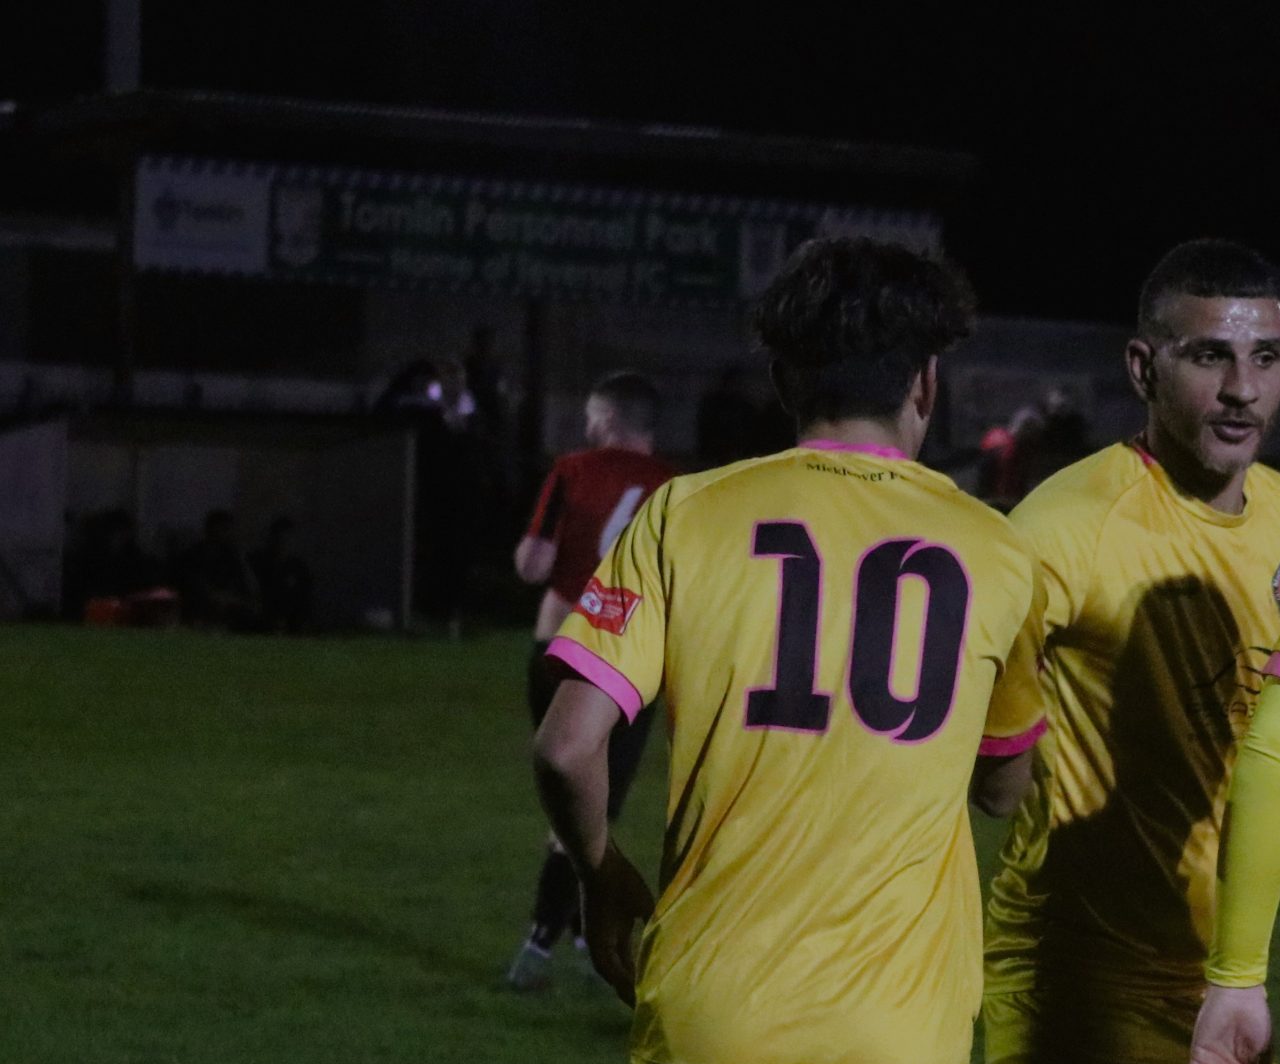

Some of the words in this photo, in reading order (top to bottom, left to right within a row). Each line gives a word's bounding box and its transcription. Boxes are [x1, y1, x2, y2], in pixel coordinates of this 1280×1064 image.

[340, 189, 455, 235] Tomlin
[465, 202, 635, 251] Personnel
[643, 213, 720, 257] Park
[806, 463, 884, 481] Micklver
[744, 518, 973, 745] 10
